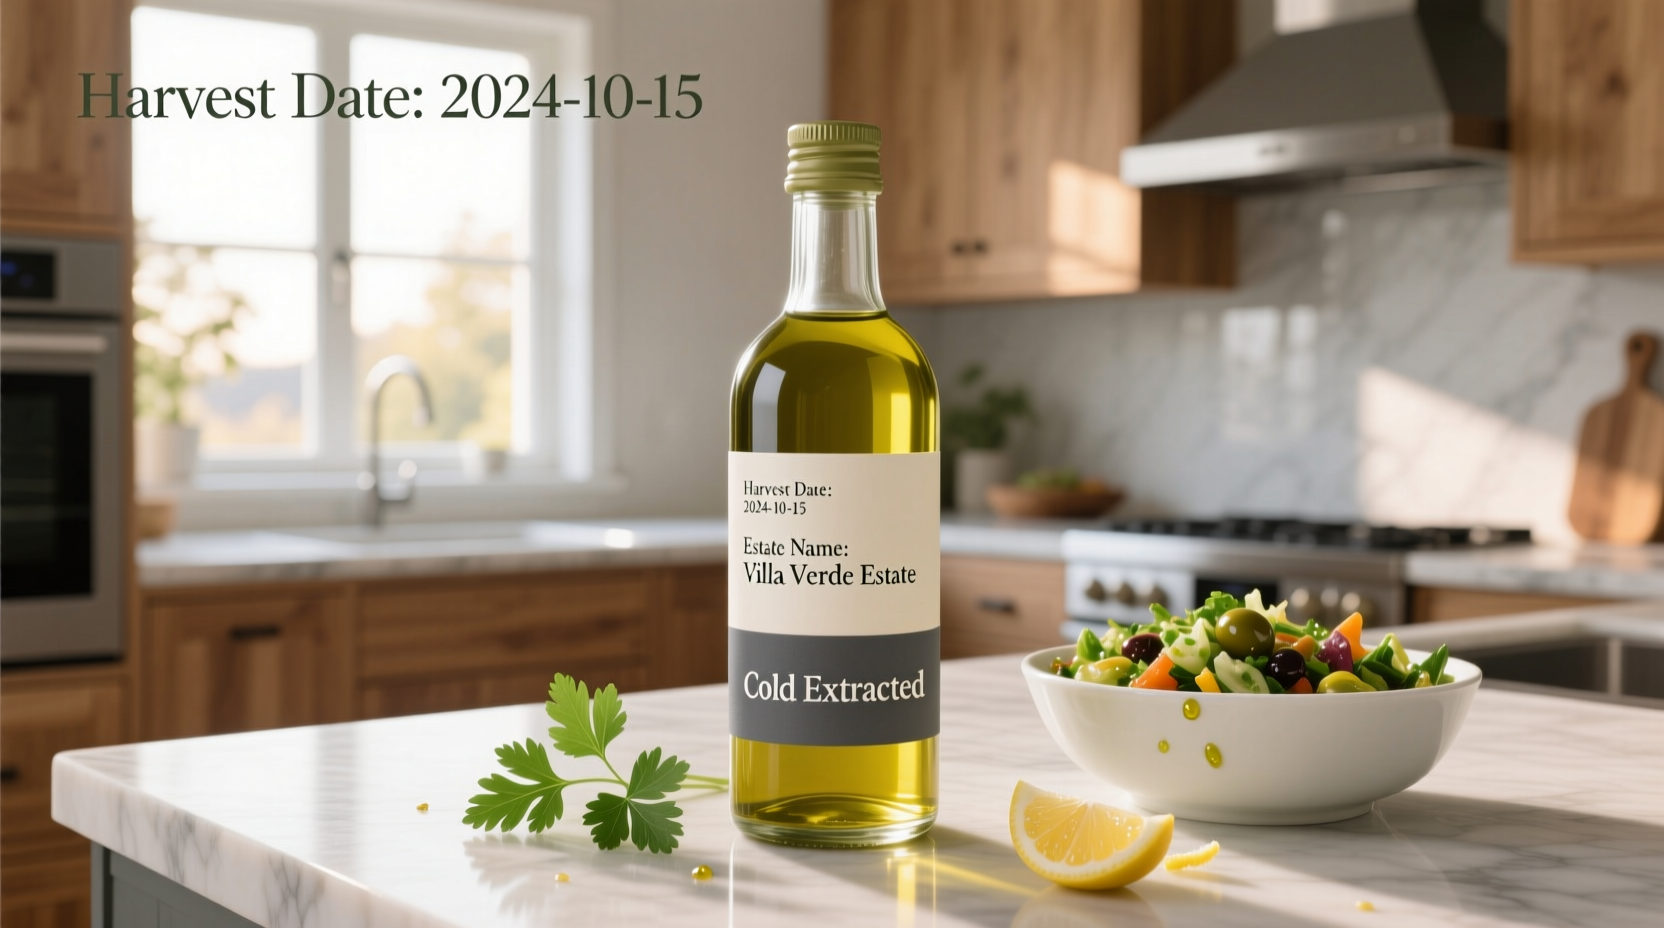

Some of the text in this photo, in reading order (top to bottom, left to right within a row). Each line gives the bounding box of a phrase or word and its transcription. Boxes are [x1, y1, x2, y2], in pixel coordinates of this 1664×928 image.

[743, 480, 832, 497] Harvest Date:
[743, 500, 807, 515] 2024-10-15
[743, 537, 849, 557] Estate Name:
[743, 561, 917, 586] Villa Verde Estate
[743, 669, 926, 704] Cold Extracted
